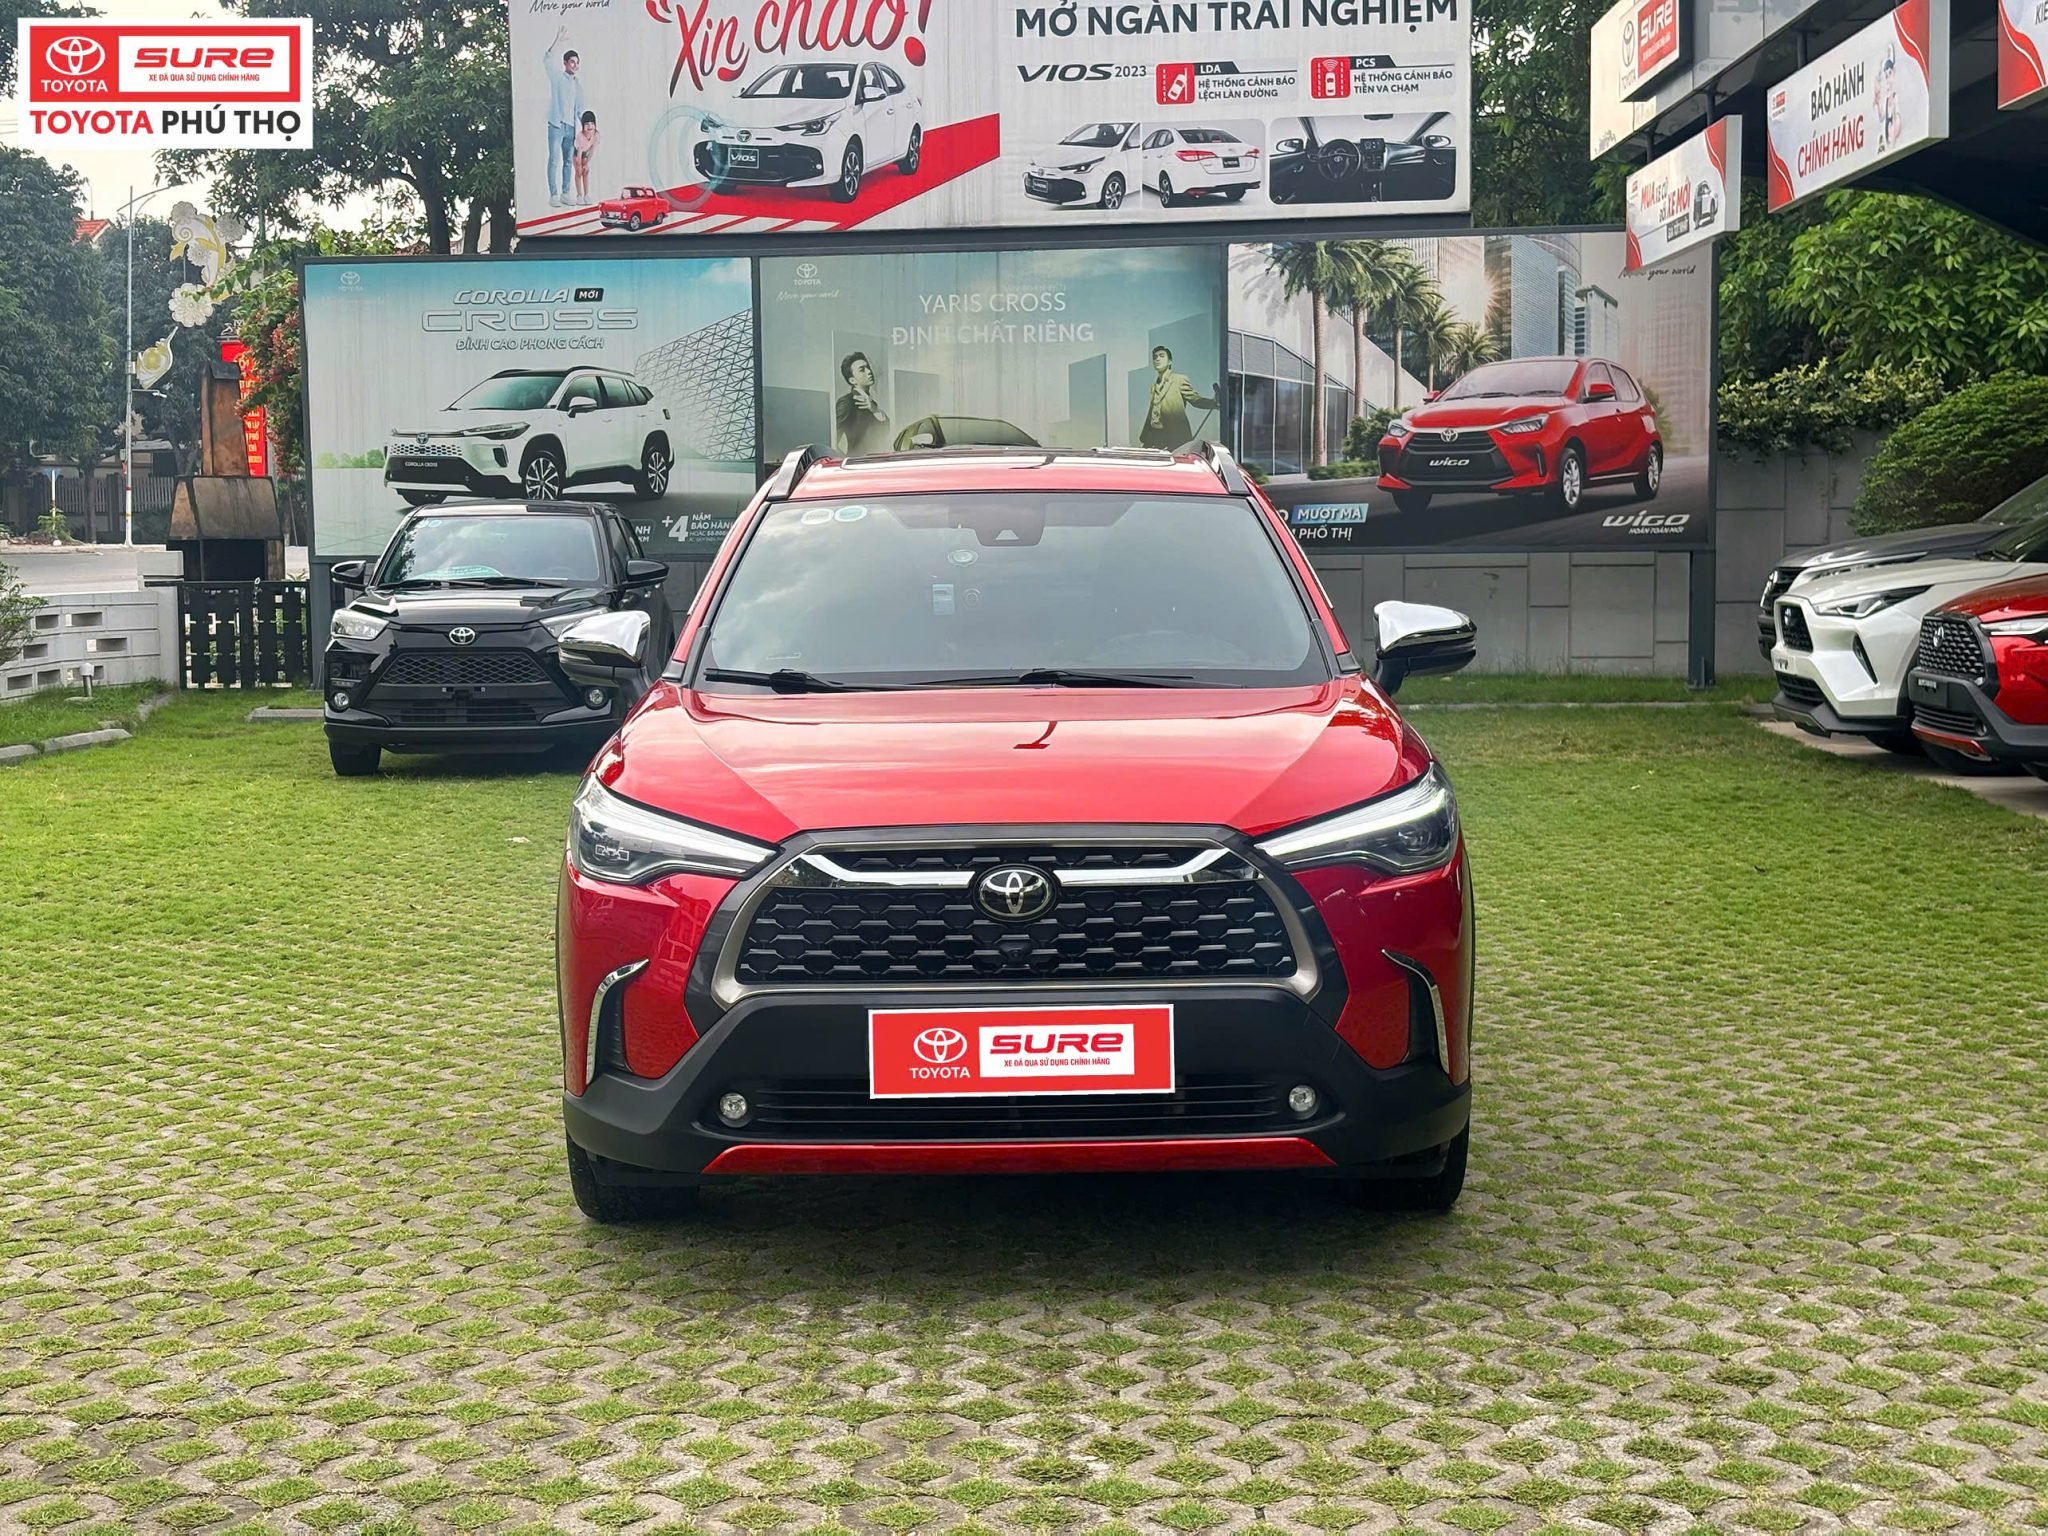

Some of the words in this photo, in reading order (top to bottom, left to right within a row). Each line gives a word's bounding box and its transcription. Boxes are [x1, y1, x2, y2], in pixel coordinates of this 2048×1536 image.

[560, 2, 583, 16] your
[585, 0, 610, 9] world
[669, 0, 750, 98] Xin
[1200, 65, 1221, 74] LDA
[1355, 58, 1376, 67] PCS
[1017, 63, 1115, 82] VIOS
[1115, 66, 1147, 77] 2023
[1354, 71, 1367, 85] HỆ
[1368, 70, 1402, 81] THỐNG
[1433, 68, 1453, 79] BÁO
[1198, 78, 1211, 89] HỆ
[1212, 76, 1246, 87] THỐNG
[1275, 75, 1296, 85] BÁO
[1376, 85, 1389, 93] VA
[1390, 83, 1419, 95] CHẠM
[1198, 90, 1221, 102] LỆCH
[1222, 88, 1242, 99] LÀN
[1811, 75, 1832, 121] BẢO
[1833, 62, 1865, 109] HÀNH
[1797, 130, 1830, 178] CHÍNH
[1832, 115, 1865, 162] HÃNG
[730, 153, 757, 162] VIOS
[1648, 269, 1669, 281] your
[1671, 264, 1696, 275] world
[453, 288, 569, 305] COROLLA
[578, 289, 600, 300] MỚI
[919, 293, 983, 314] YARIS
[988, 292, 1067, 313] CROSS
[421, 308, 639, 332] CROSS
[957, 317, 1017, 345] CHẤT
[1022, 318, 1095, 344] RIÊNG
[490, 338, 518, 351] CAO
[520, 337, 566, 350] PHONG
[568, 334, 605, 350] CÁCH
[1298, 523, 1329, 539] PHỐ
[1330, 526, 1353, 541] THỊ
